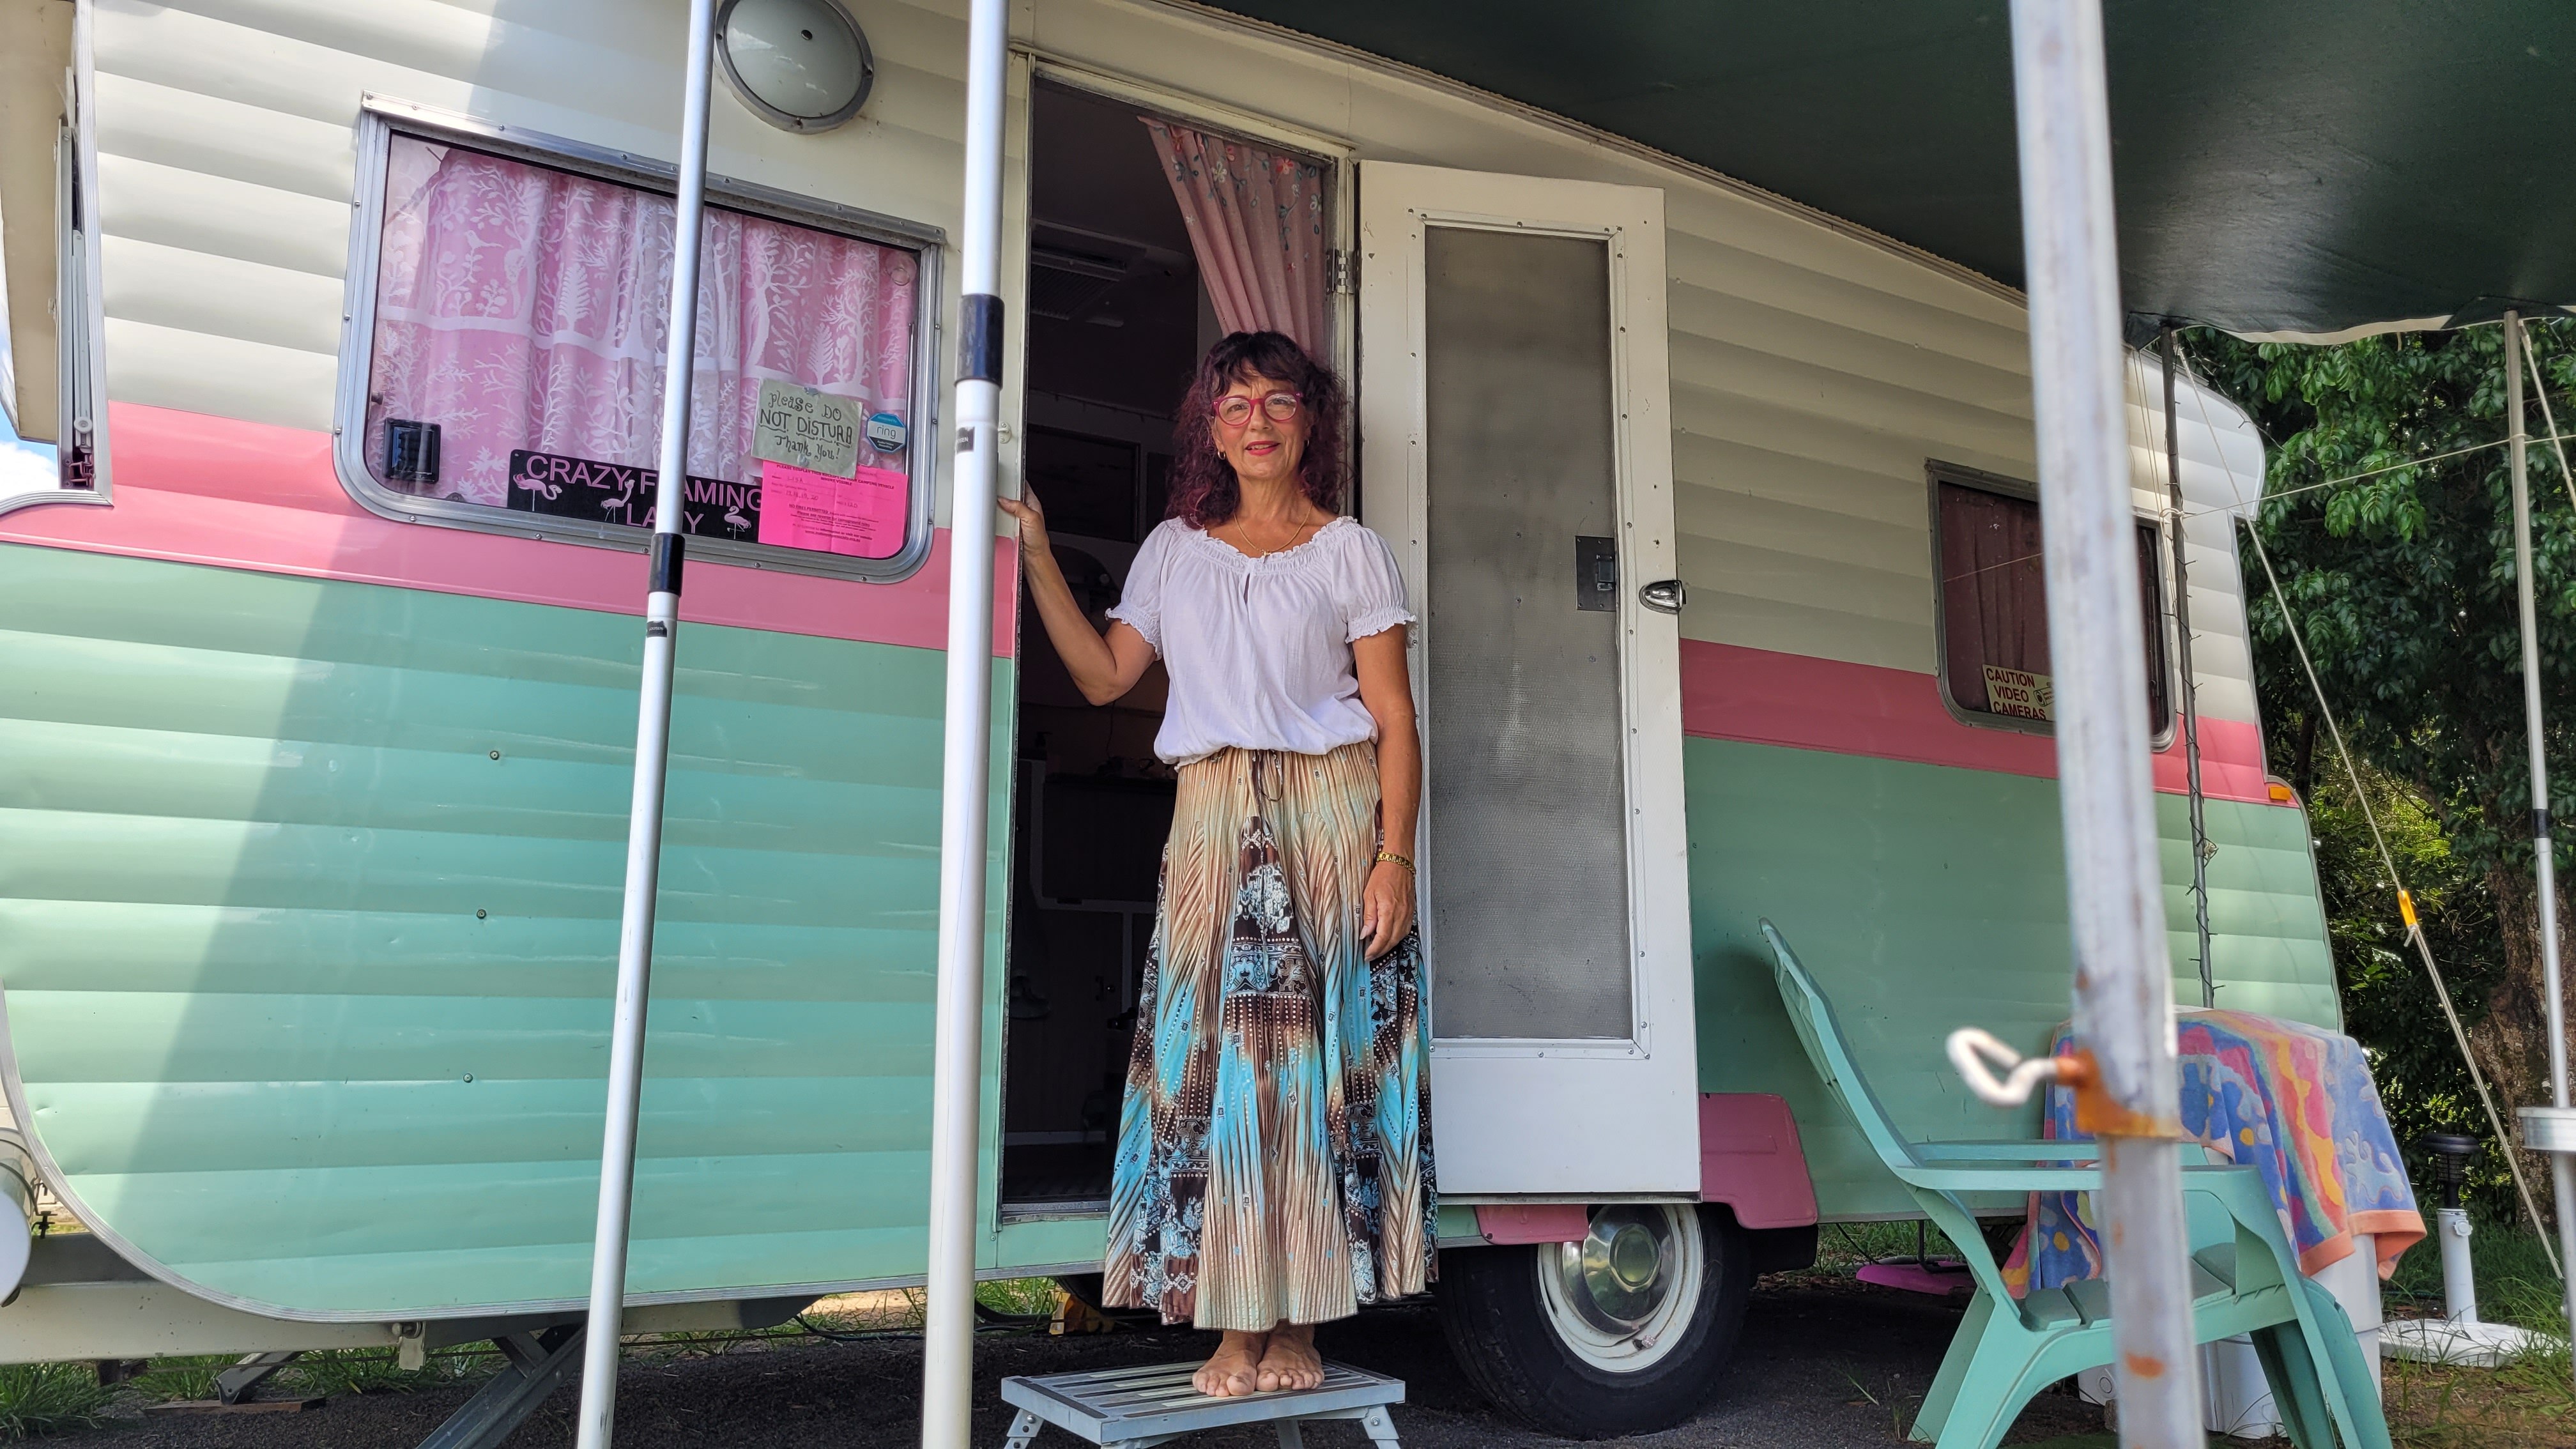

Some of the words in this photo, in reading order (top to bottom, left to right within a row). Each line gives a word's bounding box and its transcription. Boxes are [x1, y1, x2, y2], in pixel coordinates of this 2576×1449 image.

[760, 409, 792, 430] NOT
[822, 404, 841, 421] DO
[877, 425, 896, 440] ring
[774, 436, 811, 457] Thank
[815, 443, 840, 462] You!
[526, 455, 632, 491] CRAZY
[626, 503, 705, 534] LAY
[1986, 668, 2035, 689] CAUTION
[1993, 684, 2029, 703] VIDEO
[1993, 701, 2046, 720] CAMERAS
